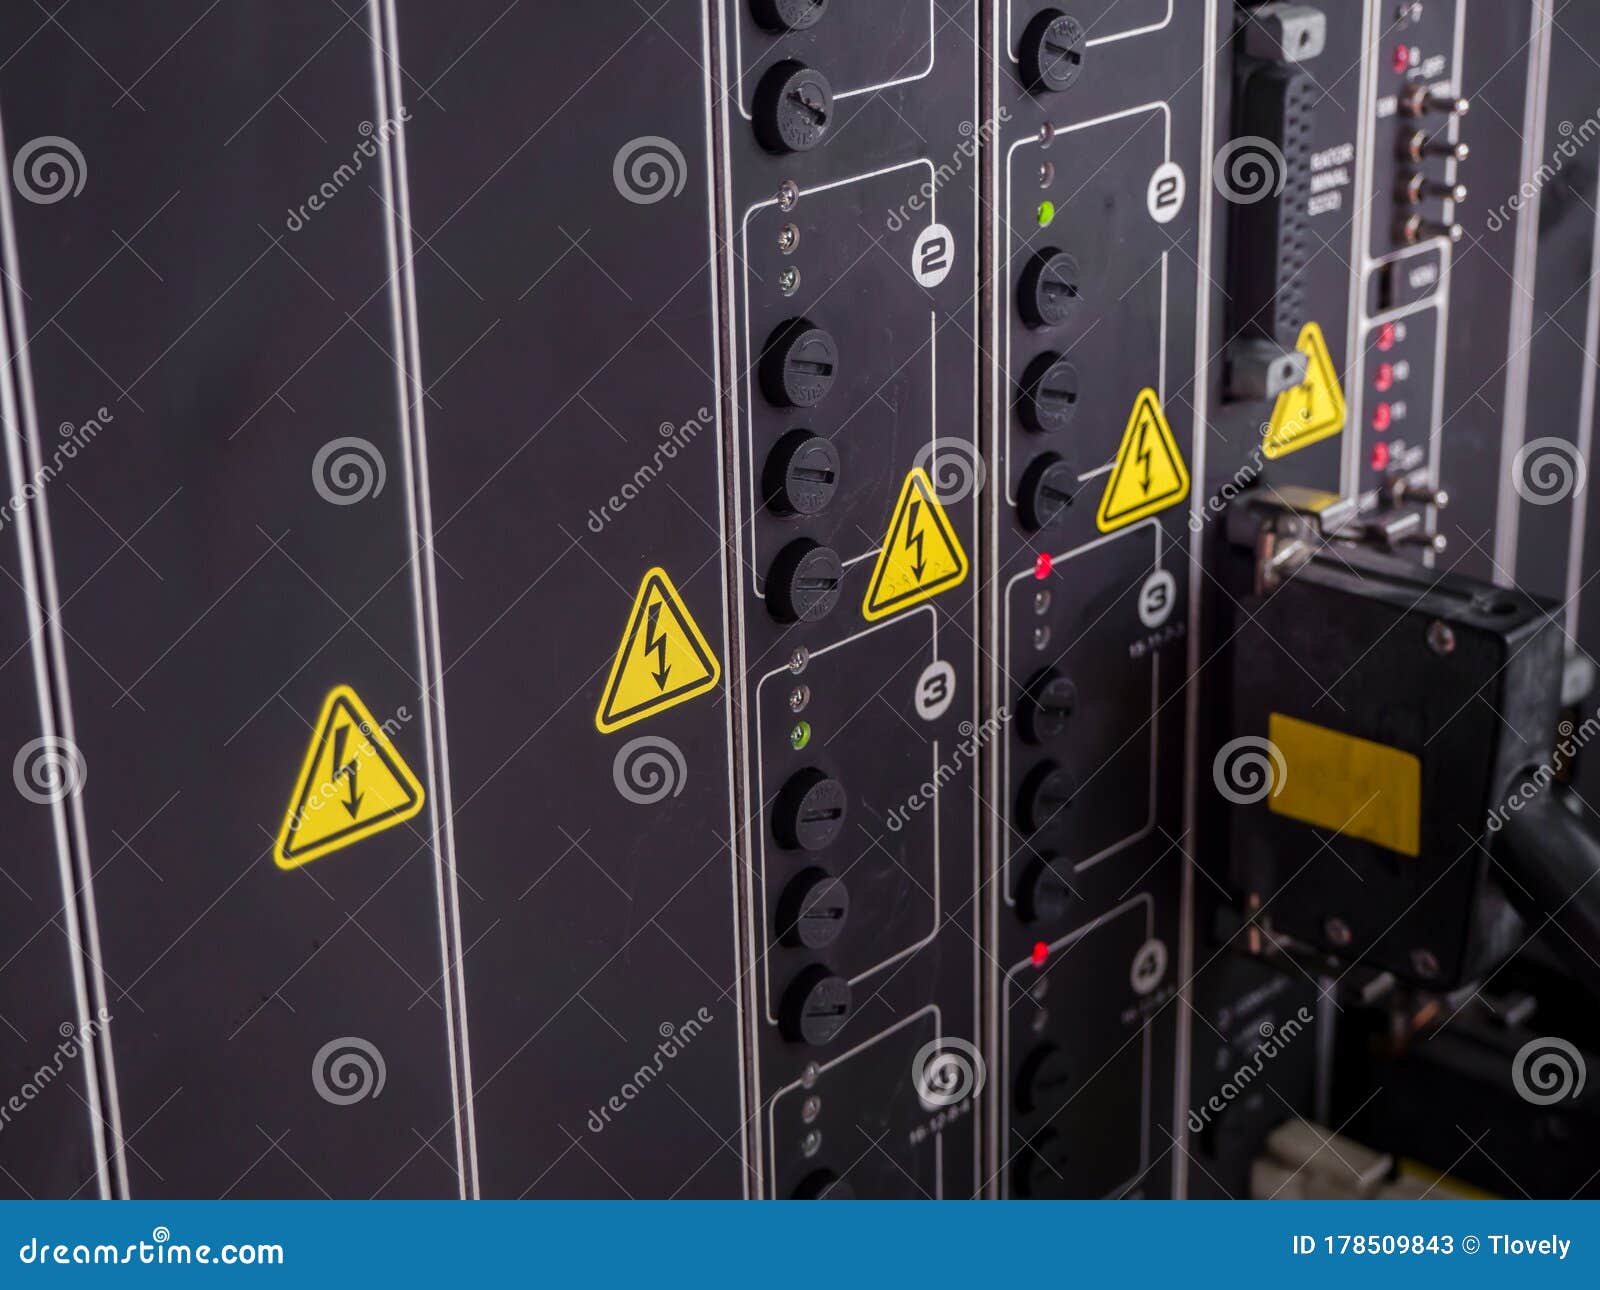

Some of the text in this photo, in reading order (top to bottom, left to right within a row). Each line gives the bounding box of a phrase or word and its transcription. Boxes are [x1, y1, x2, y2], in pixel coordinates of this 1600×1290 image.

[1156, 175, 1178, 210] 2
[921, 236, 947, 275] 2
[1146, 582, 1167, 614] 3
[923, 673, 948, 707] 3
